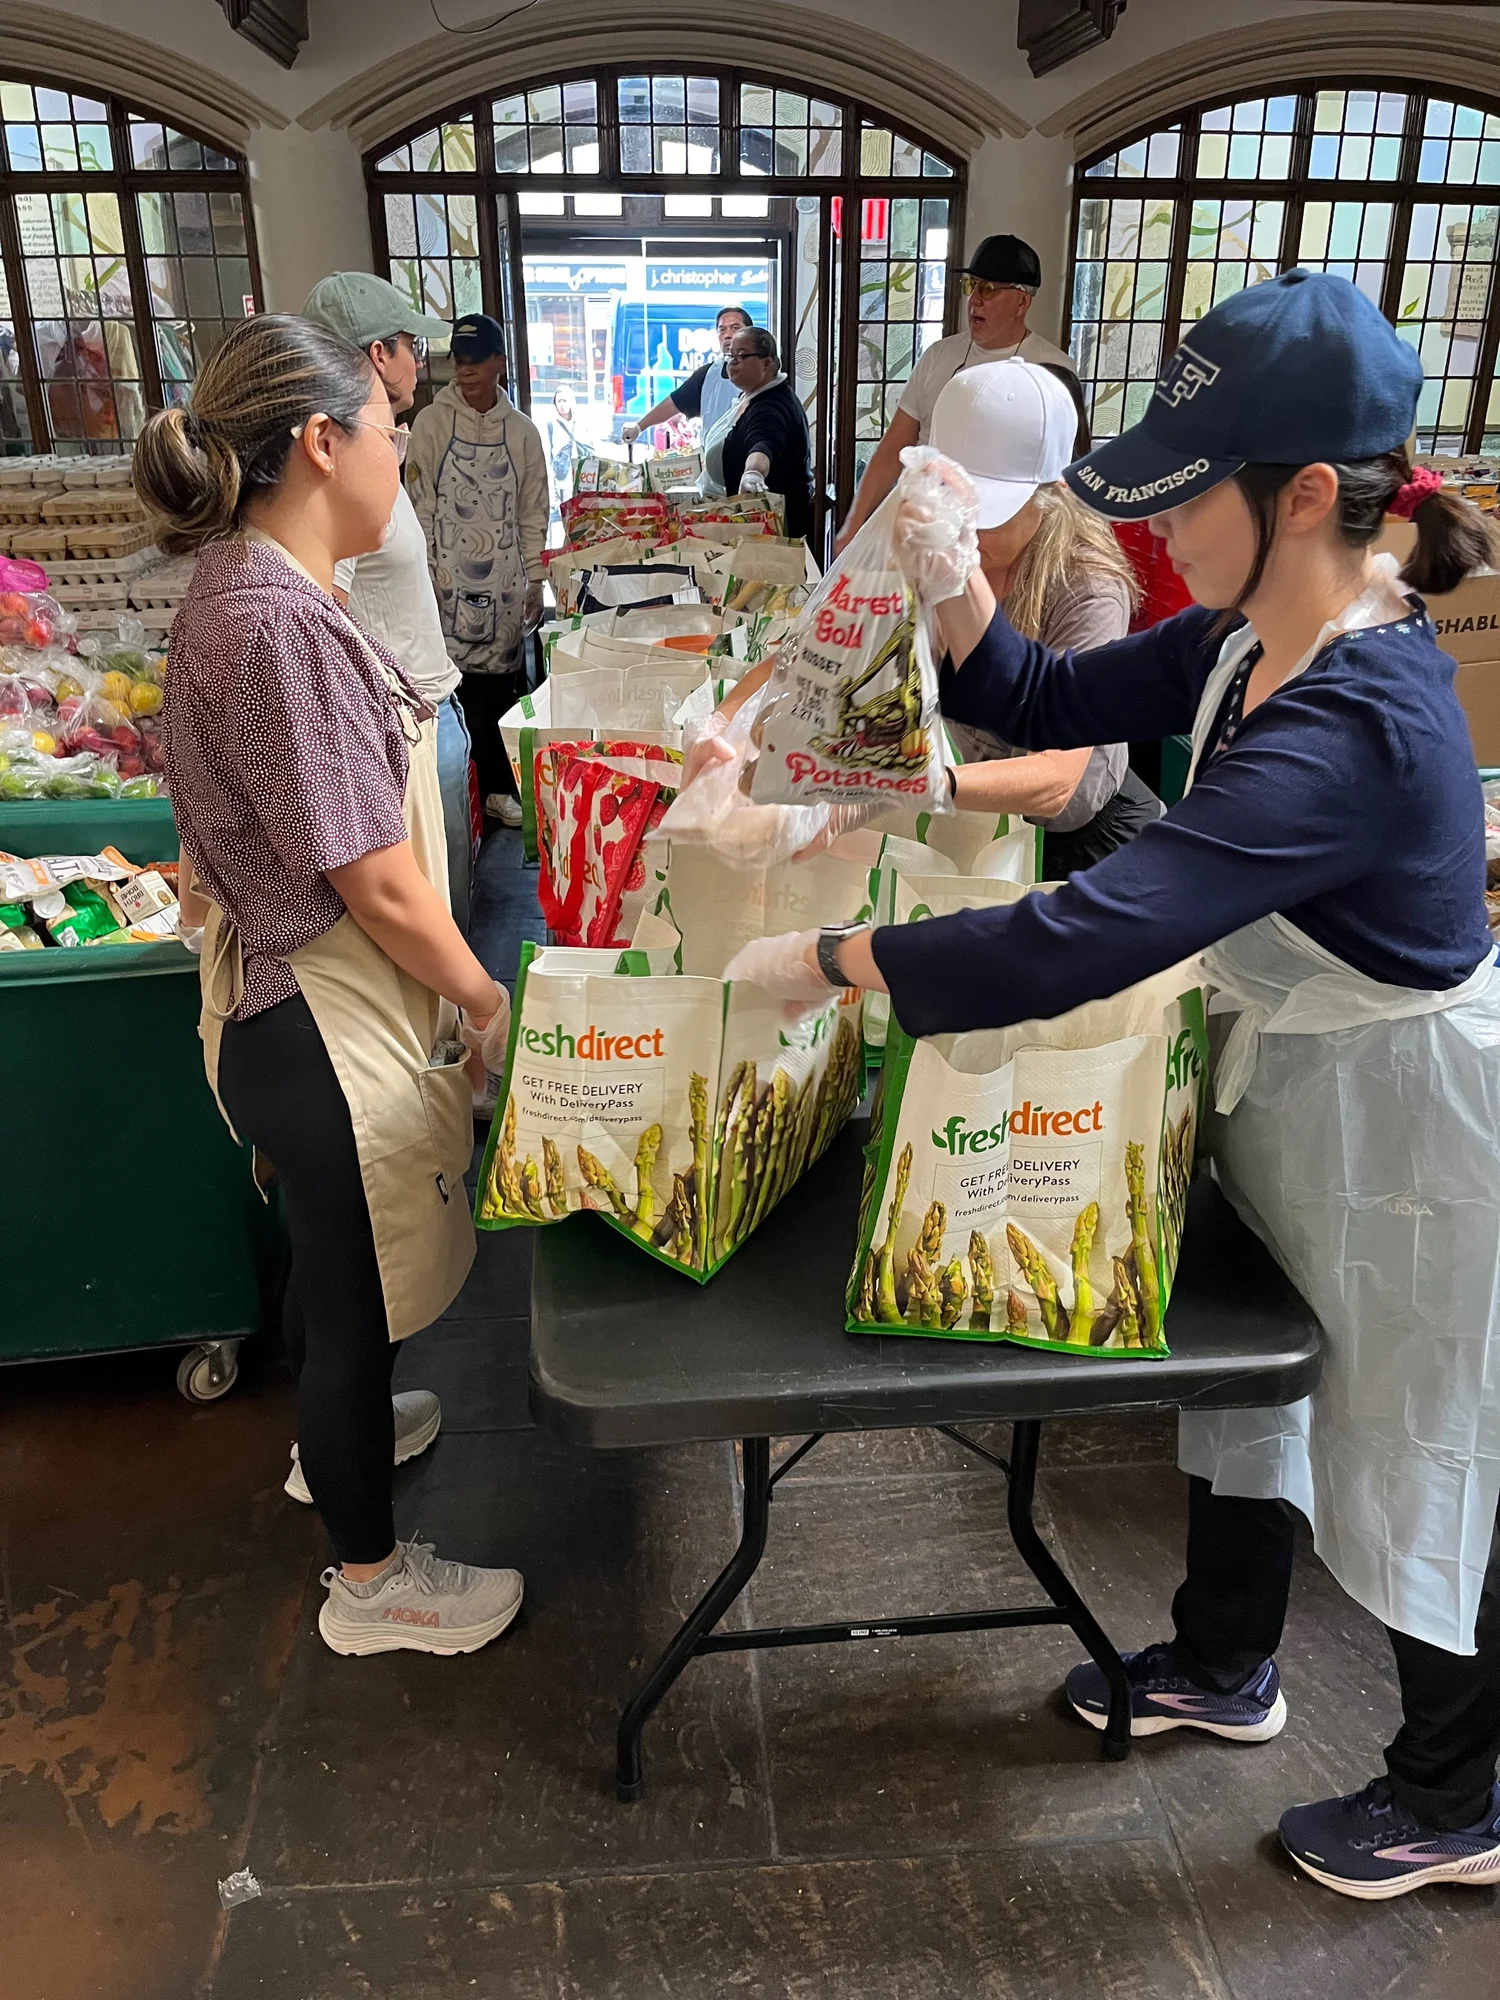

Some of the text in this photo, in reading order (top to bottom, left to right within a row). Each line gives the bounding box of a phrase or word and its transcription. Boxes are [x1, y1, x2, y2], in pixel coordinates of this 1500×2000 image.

[1077, 458, 1211, 503] SAN FRANCISCO
[785, 752, 928, 794] Potatoes
[519, 1024, 666, 1061] reshdirect
[522, 1075, 643, 1097] GET FREE DELIVERY
[530, 1091, 634, 1111] With DeliveryPass
[943, 1100, 1104, 1156] freshdirect
[960, 1174, 985, 1188] GET
[1013, 1159, 1081, 1172] DELIVERY
[967, 1186, 994, 1200] With
[383, 1607, 440, 1628] HOKA
